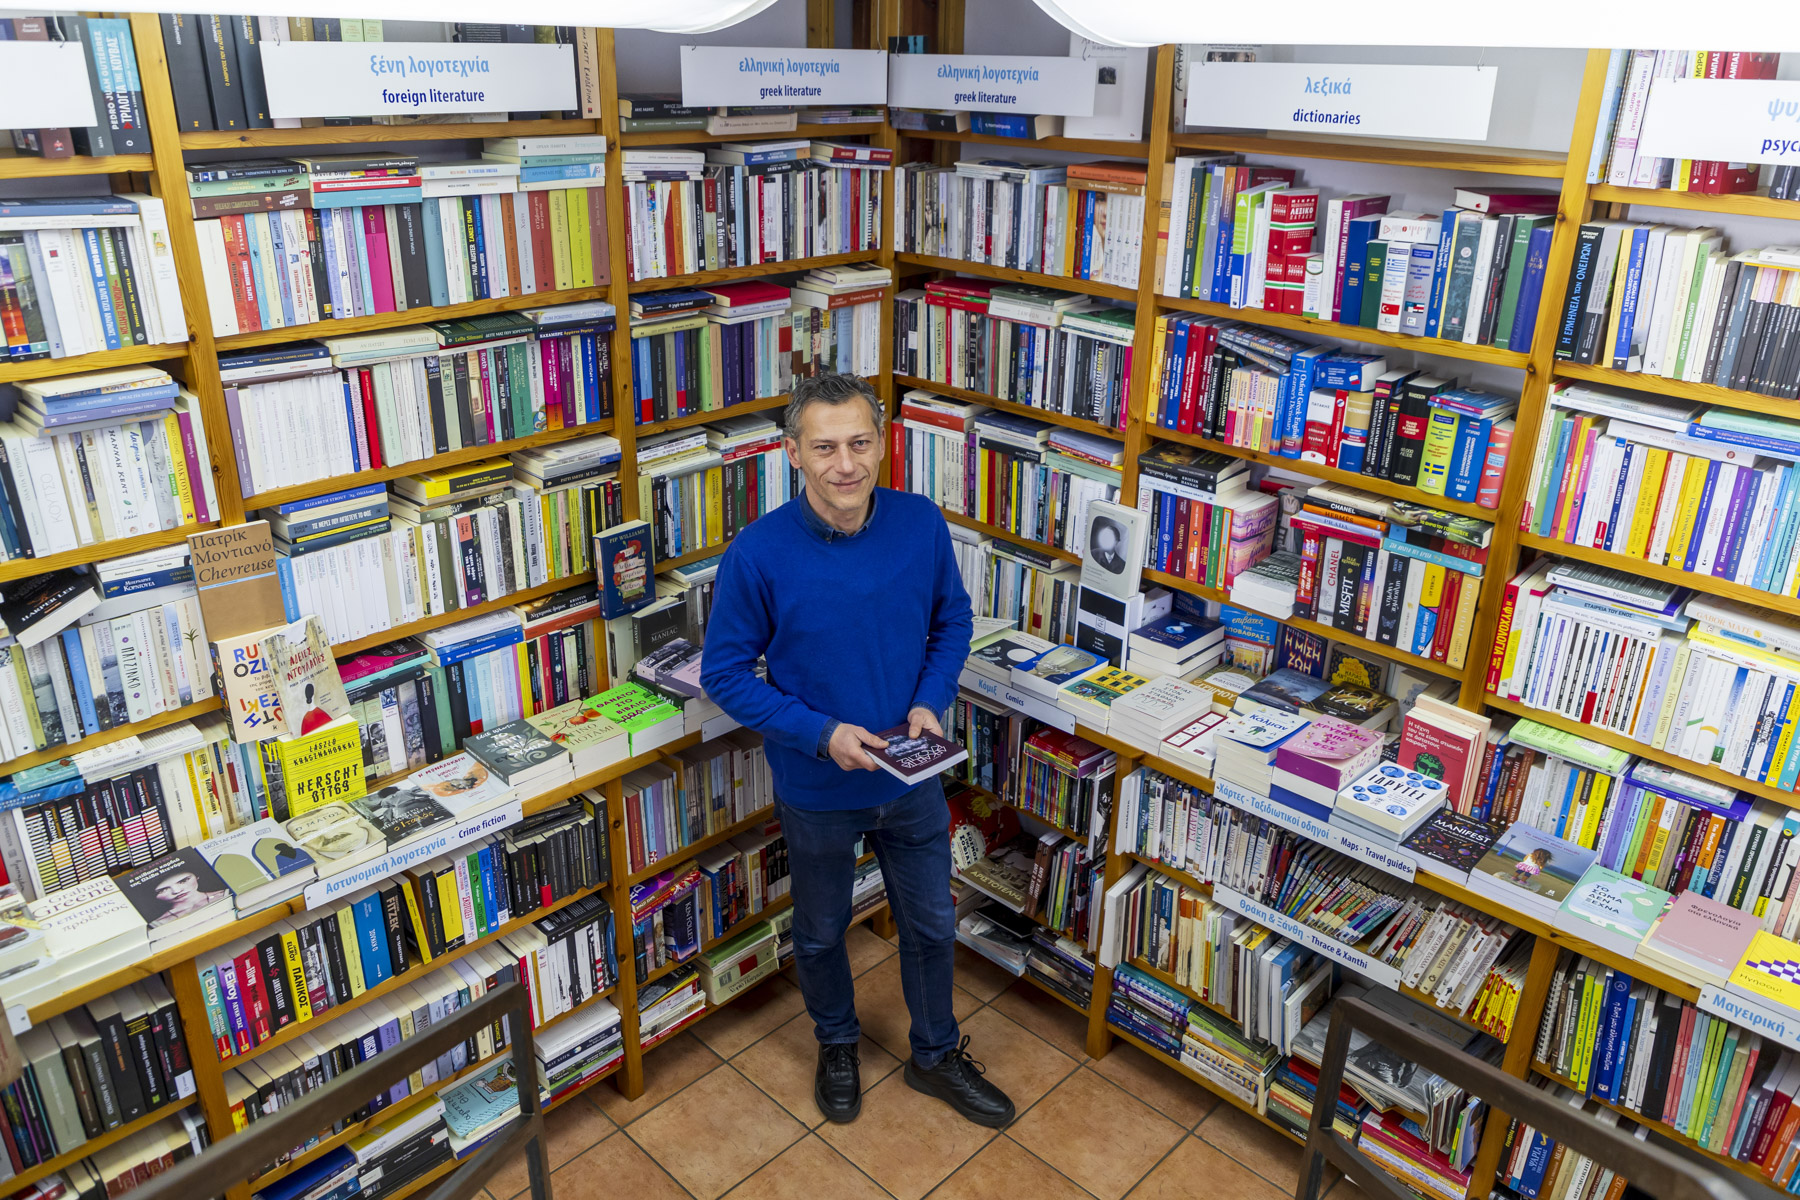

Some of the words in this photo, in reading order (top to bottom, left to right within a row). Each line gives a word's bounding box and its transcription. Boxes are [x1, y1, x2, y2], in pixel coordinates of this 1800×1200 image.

[370, 55, 406, 80] ξένη
[408, 55, 490, 80] λογοτεχνία
[738, 57, 785, 76] ελληνική
[786, 58, 840, 77] λογοτεχνία
[937, 64, 980, 82] ελληνική
[982, 66, 1039, 84] λογοτεχνία
[760, 84, 783, 100] greek
[784, 84, 822, 97] literature
[1305, 76, 1352, 96] λεξικά
[382, 89, 427, 107] foreign
[429, 88, 485, 103] literature
[954, 92, 977, 104] greek
[978, 92, 1017, 104] literature
[1293, 109, 1361, 125] dictionaries
[1761, 138, 1800, 156] psyc
[716, 217, 726, 227] Το
[717, 228, 727, 248] δίκιο
[1564, 298, 1580, 337] ΕΡΜΗΝΕΙΑ
[1575, 242, 1593, 281] ΟΝΕΙΡΩΝ
[1299, 375, 1308, 392] Oxford
[108, 429, 123, 469] HANNAH
[117, 470, 129, 495] KENT
[1330, 502, 1356, 515] CHANEL
[1323, 519, 1349, 530] PRADA
[190, 529, 248, 550] Πατρίκ
[618, 528, 645, 542] WILLIAMS
[194, 541, 272, 567] Μοντιανό
[198, 558, 275, 583] Chevreuse
[1327, 550, 1340, 588] CHANEL
[21, 599, 57, 622] HARPER
[57, 586, 76, 602] LEE
[1339, 576, 1354, 617] MISFIT
[1584, 602, 1608, 613] ΕΤΑΙΡΕΙΑ
[1608, 607, 1618, 616] ΤΟΥ
[1619, 610, 1633, 619] ΕΝΟΣ
[1696, 610, 1726, 626] GABOR
[651, 627, 679, 643] MANIAC
[1493, 606, 1513, 656] ΨΥΧΟΛΟΓΙΑ
[288, 646, 313, 667] ΑΔΕΙΕΣ
[1284, 633, 1293, 648] Η
[1294, 639, 1321, 662] ΜΙΣΗ
[286, 654, 326, 682] ΝΤΟΥΛΑΠΕΣ
[1287, 651, 1312, 676] ΖΩΗ
[978, 679, 998, 697] Κόμιξ
[596, 689, 639, 709] ΘΑΝΑΤΟΣ
[614, 698, 634, 708] ΣΤΟ
[615, 699, 648, 716] ΒΙΒΛΙΟ
[1005, 692, 1024, 707] Comics
[620, 703, 657, 720] ΠΩΛΕΙΟ
[1249, 713, 1289, 731] Κάλμαν
[1337, 724, 1359, 734] ΟΣΑ
[1413, 723, 1430, 735] τέχνη
[1405, 736, 1428, 751] καιρούς
[1413, 734, 1441, 751] άστατους
[1425, 732, 1440, 742] είσαι
[1440, 740, 1464, 754] στωικός
[293, 741, 356, 767] KRASZNAHORKAI
[296, 764, 359, 797] HERSCHT
[1367, 773, 1428, 801] ΙΔΡΥΤΕΣ
[311, 780, 349, 804] 07769
[400, 811, 435, 829] Ιταλός
[1217, 783, 1245, 806] Χάρτες
[1250, 796, 1301, 828] Ταξιδιωτικοί
[1300, 819, 1331, 841] οδηγοί
[1340, 837, 1359, 853] Maps
[1364, 846, 1388, 865] Travel
[1387, 856, 1411, 875] guides
[1434, 819, 1493, 845] MANIFEST
[325, 857, 390, 895] Αστυνομική
[390, 837, 448, 869] λογοτεχνία
[458, 821, 481, 840] Crime
[481, 812, 507, 835] fiction
[48, 878, 110, 905] Graham
[969, 870, 1025, 902] ΑΡΙΣΤΟΤΕΛΗΣ
[1591, 888, 1623, 904] ΣΩΜΑ
[1595, 884, 1610, 893] ΤΟ
[32, 883, 117, 919] Greene
[1584, 898, 1620, 915] ΞΕΧΝΑ
[1587, 894, 1610, 905] ΔΕΝ
[56, 898, 117, 926] επίτιμος
[62, 904, 129, 933] πρόξενος
[385, 896, 400, 932] FITZEK
[1690, 904, 1742, 927] Φρενολογία
[1703, 913, 1740, 932] ελληνικά
[1239, 899, 1268, 924] Θράκη
[1268, 913, 1276, 924] &
[1277, 917, 1305, 942] Ξάνθη
[1311, 934, 1336, 955] Thrace
[1335, 946, 1343, 957] &
[1342, 951, 1369, 971] Xanthi
[292, 967, 309, 1010] ΠΑΝΙΚΟΣ
[1739, 973, 1783, 994] Ηγήσου!
[1712, 994, 1786, 1037] Μαγειρική
